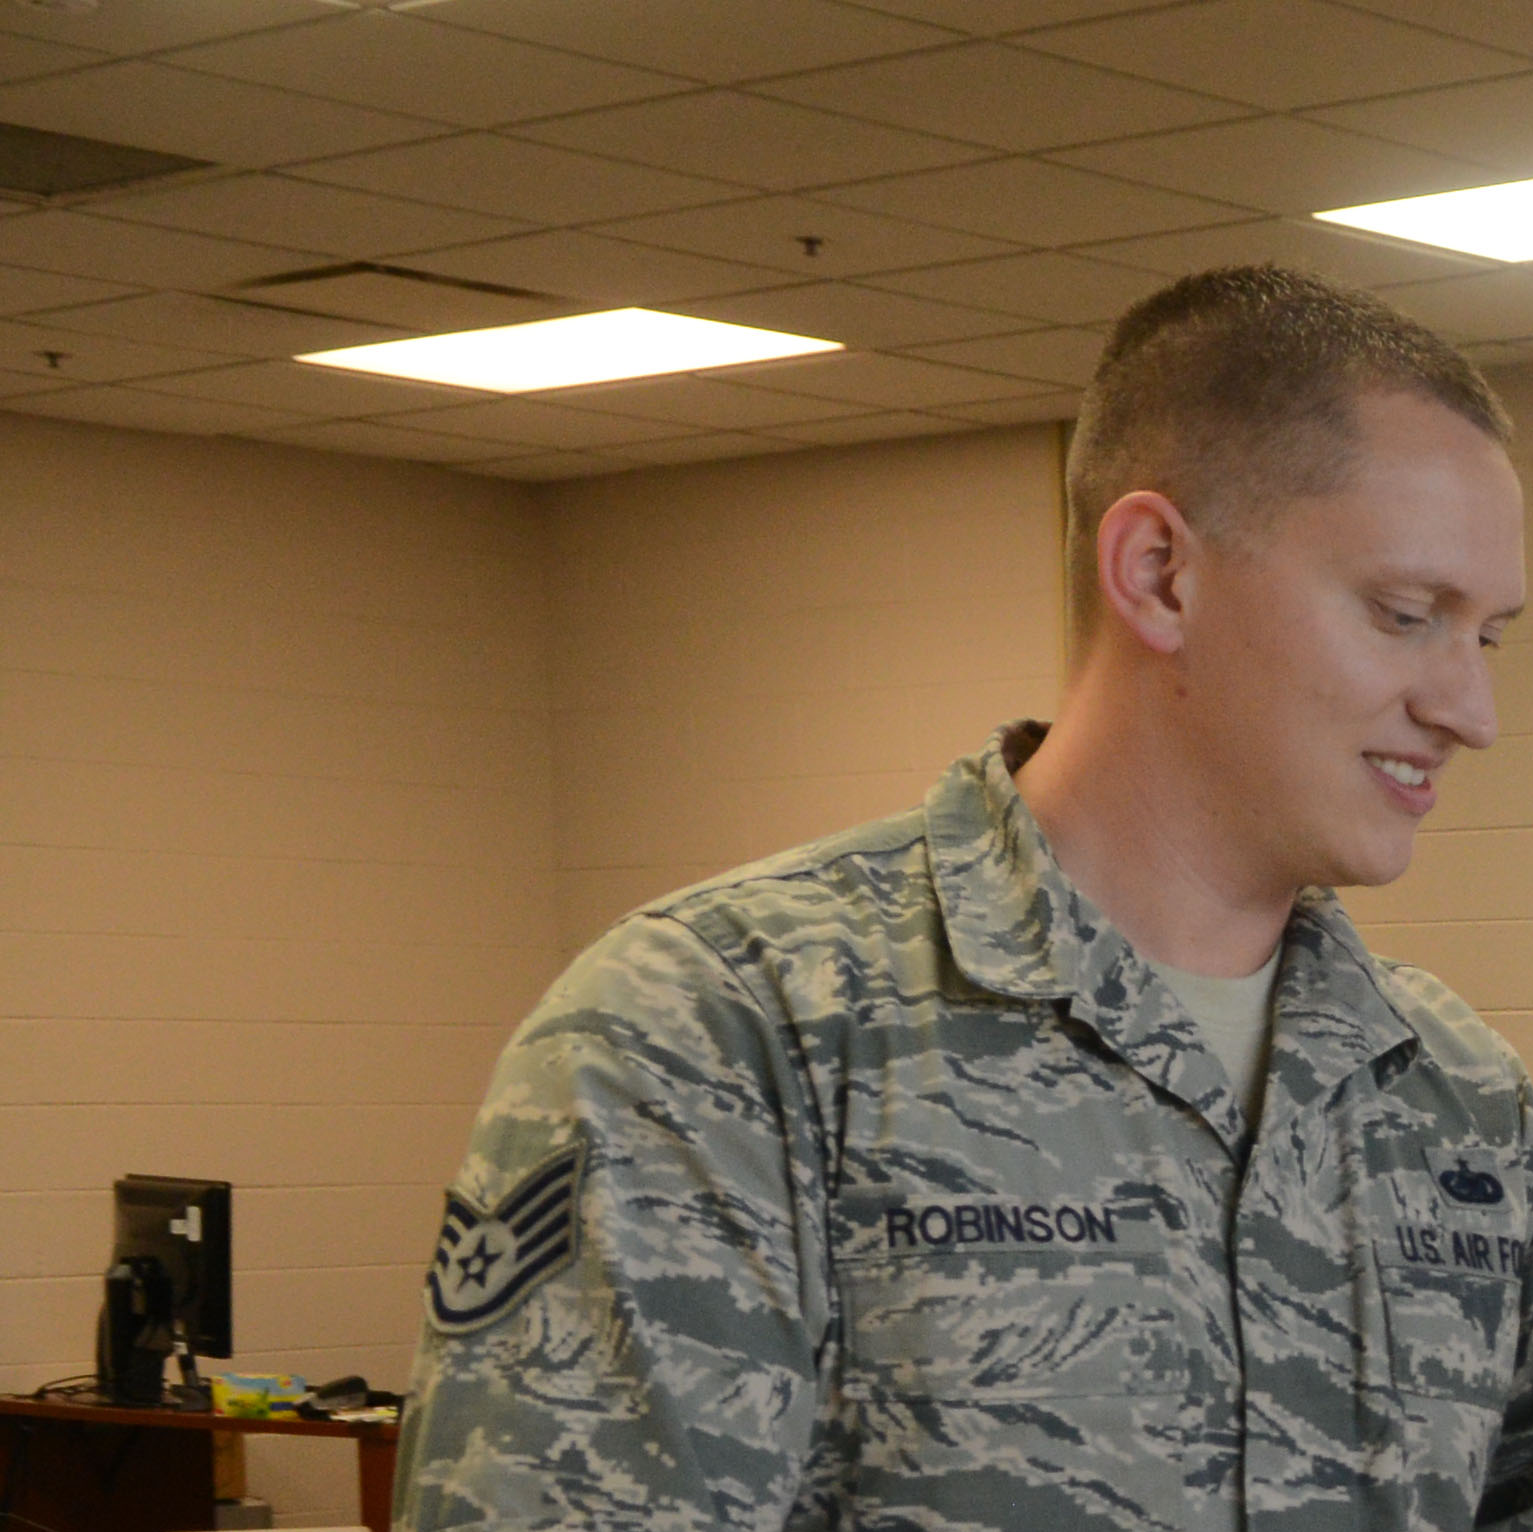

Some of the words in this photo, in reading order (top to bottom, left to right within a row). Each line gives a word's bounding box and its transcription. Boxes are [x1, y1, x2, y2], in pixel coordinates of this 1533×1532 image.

[886, 1204, 1117, 1247] ROBINSON
[1396, 1225, 1446, 1265] U.S.
[1452, 1230, 1494, 1271] AIR
